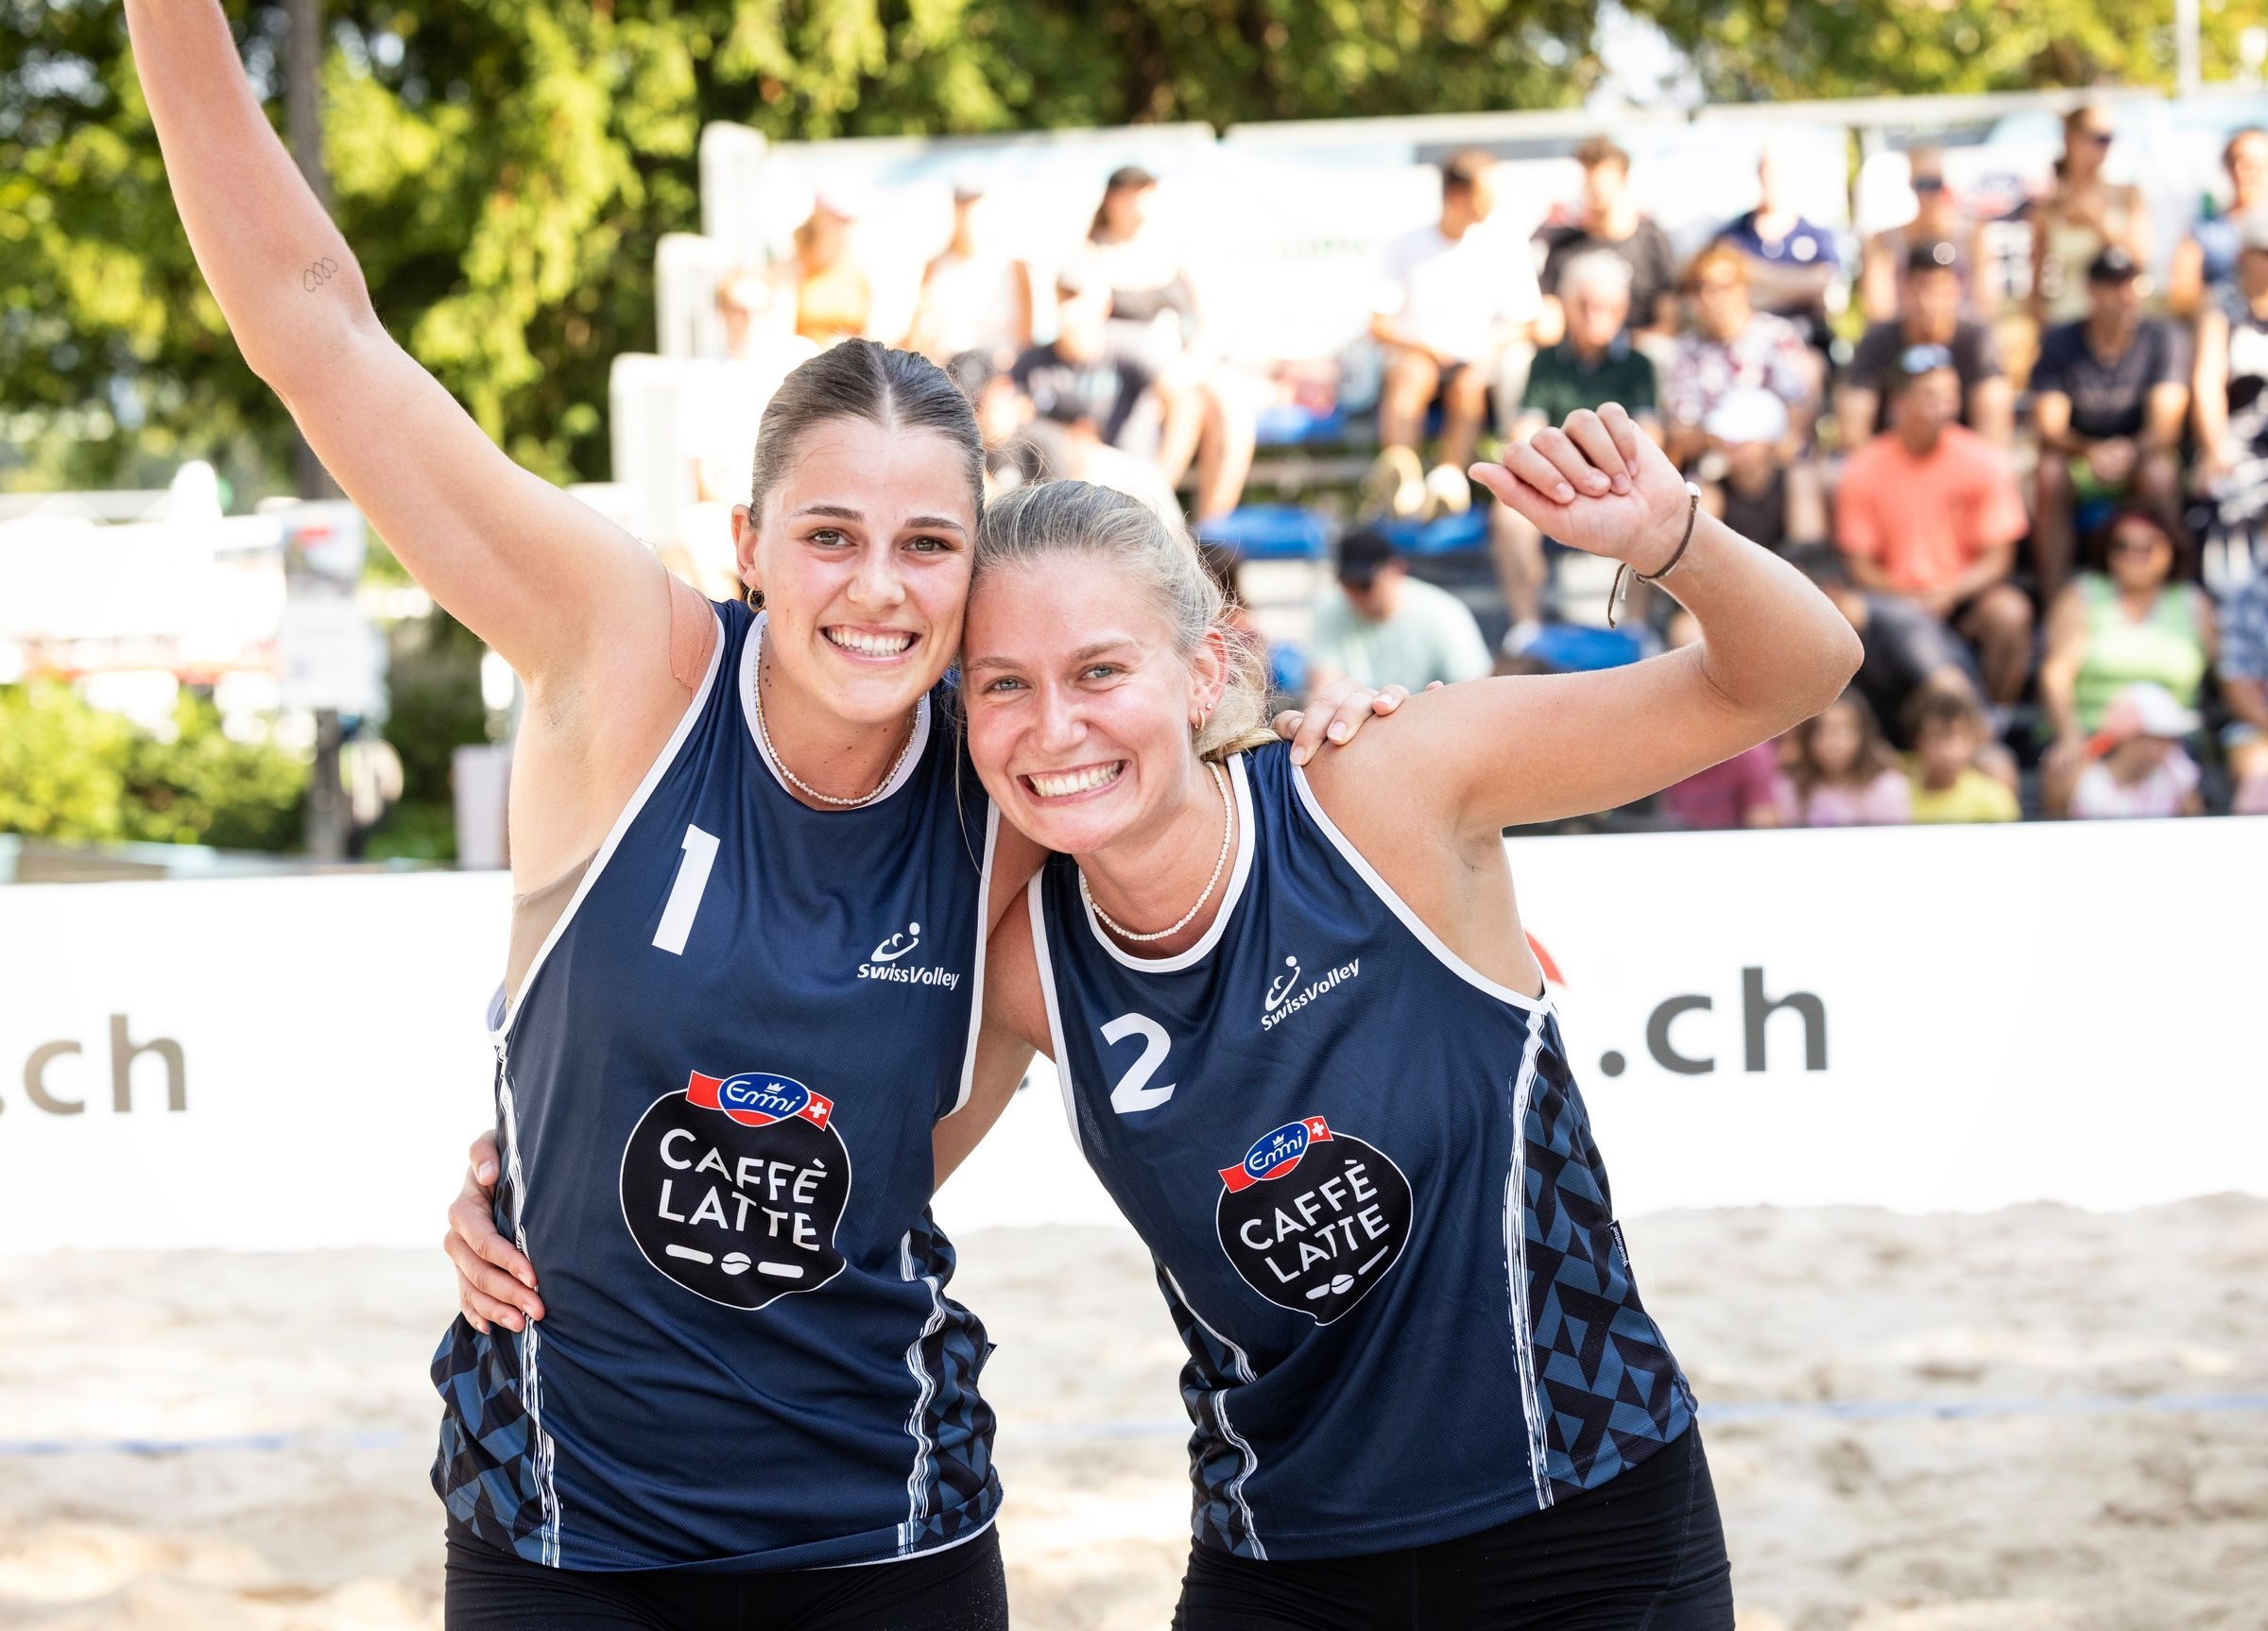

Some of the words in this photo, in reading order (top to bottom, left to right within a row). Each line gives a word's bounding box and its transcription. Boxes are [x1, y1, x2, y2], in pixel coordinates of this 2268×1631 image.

[652, 823, 720, 955] 1
[857, 962, 960, 991] SwissVolley
[1261, 957, 1360, 1032] SwissVolley
[1599, 966, 1829, 1078] .ch
[0, 1013, 188, 1116] ch
[725, 1079, 801, 1113] Emmi
[1100, 1012, 1177, 1114] 2
[660, 1128, 828, 1204] CAFFÈ
[1248, 1131, 1303, 1172] Emmi
[658, 1178, 820, 1252] LATTE
[1240, 1158, 1378, 1250] CAFFÈ
[1264, 1203, 1390, 1283] LATTE
